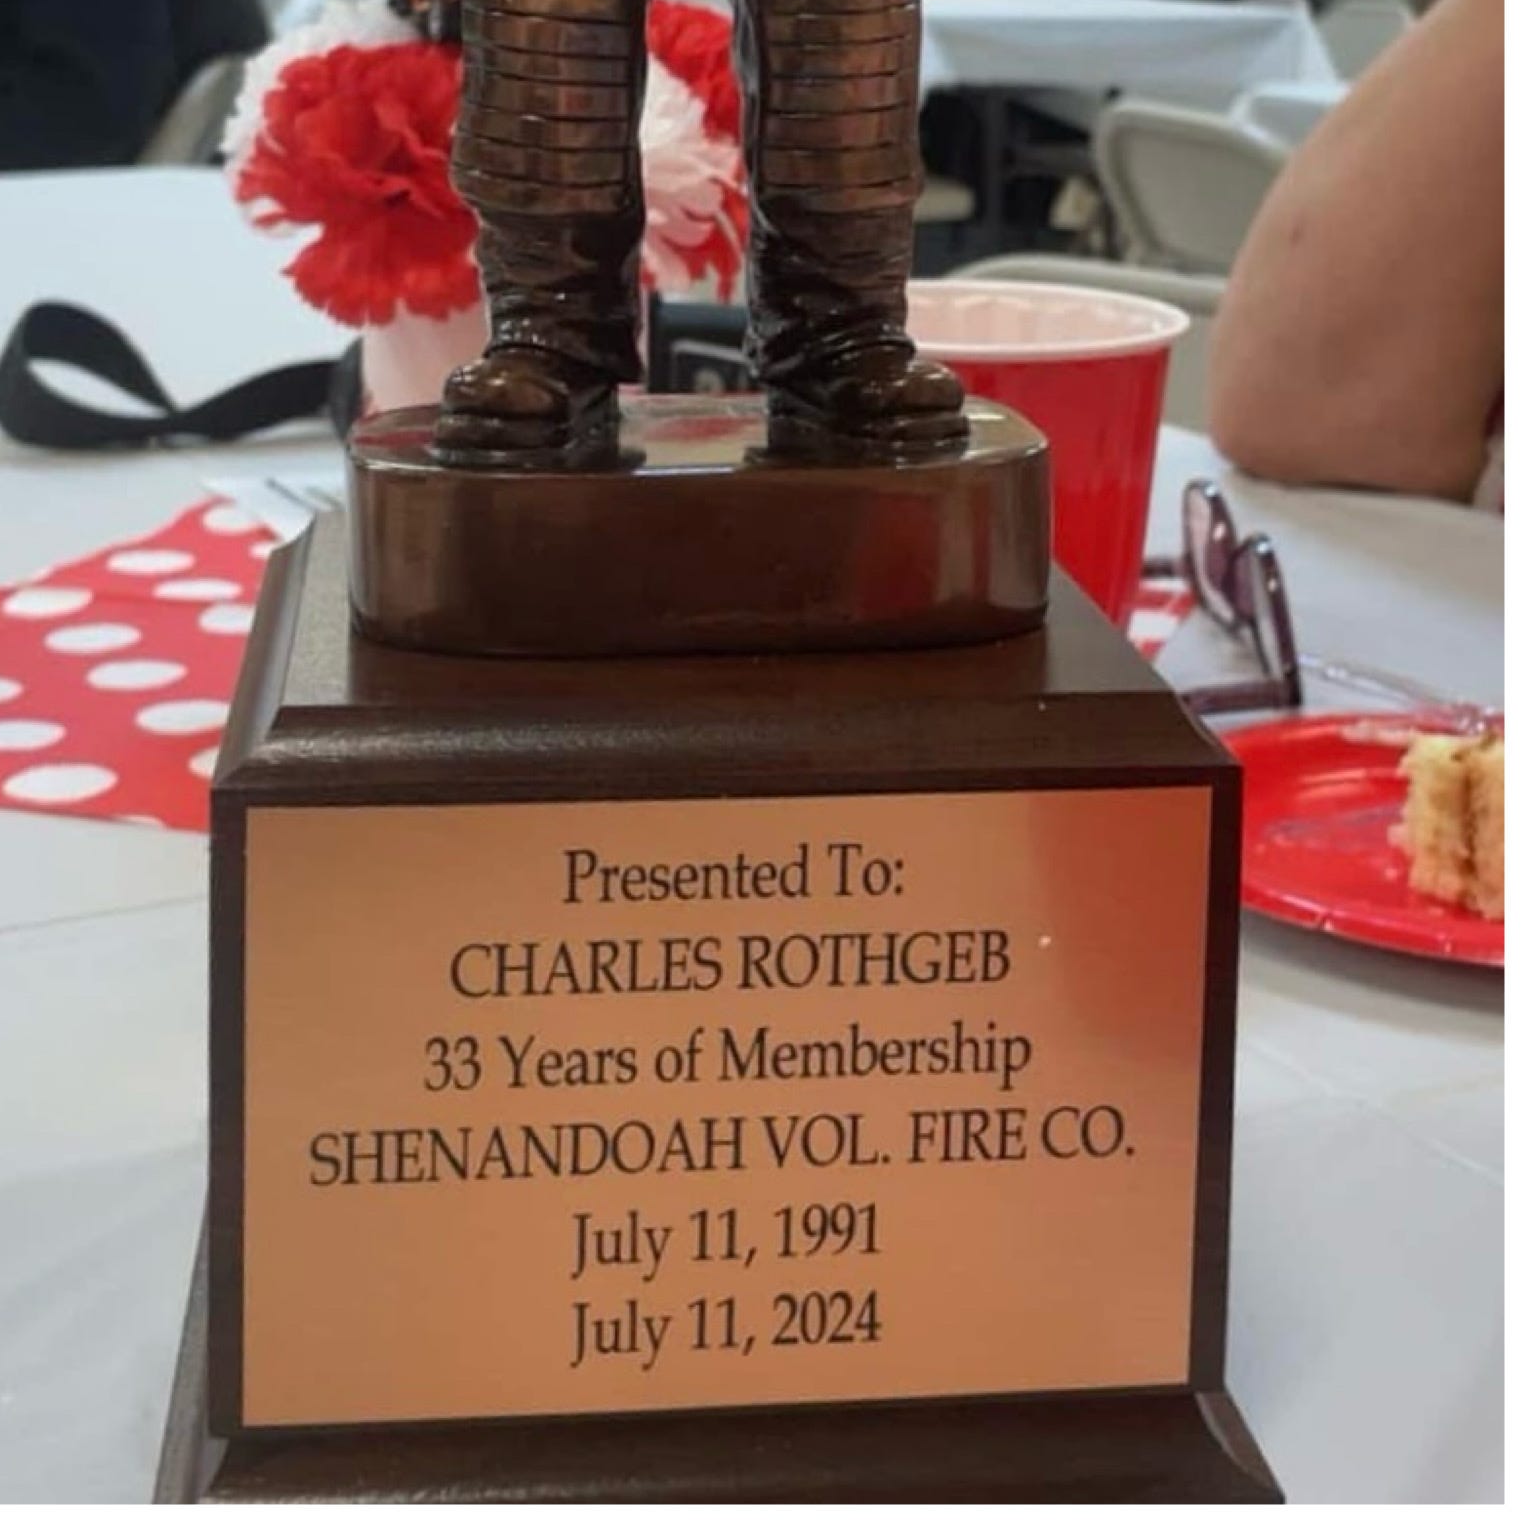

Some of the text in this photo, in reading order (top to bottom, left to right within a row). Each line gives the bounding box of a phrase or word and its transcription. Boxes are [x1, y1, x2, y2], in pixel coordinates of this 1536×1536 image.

[562, 841, 905, 905] Presented To:
[449, 928, 1012, 1000] CHARLES ROTHGEB
[423, 1018, 1033, 1093] 33 Years of Membership
[308, 1104, 1136, 1188] SHENANDOAH VOL. FIRE CO.
[569, 1201, 881, 1284] July 11, 1991
[568, 1288, 884, 1373] July 11, 2024
